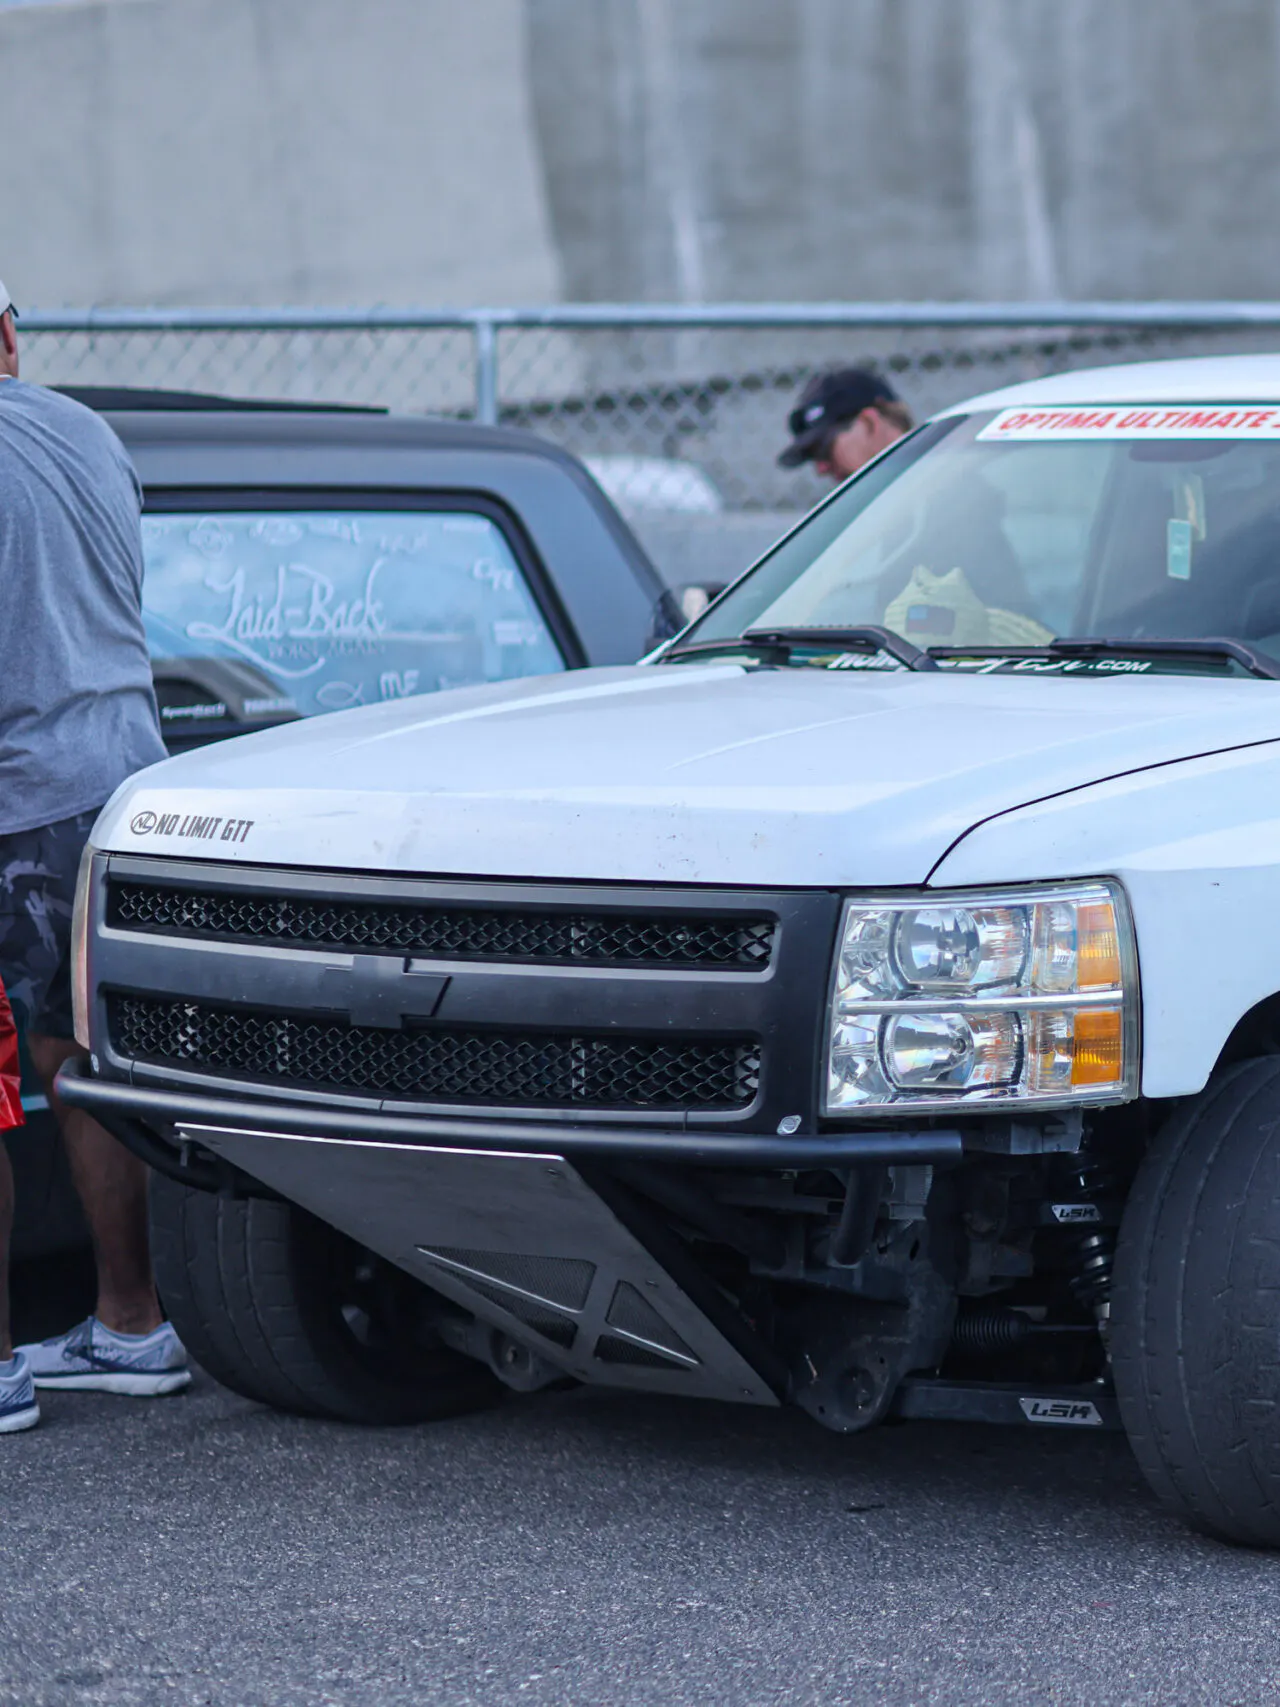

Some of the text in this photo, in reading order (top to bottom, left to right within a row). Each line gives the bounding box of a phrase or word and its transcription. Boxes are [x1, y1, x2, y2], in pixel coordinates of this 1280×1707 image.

[1000, 412, 1118, 430] OPTIMA
[1116, 411, 1276, 429] ULTIMATE
[154, 814, 180, 835] NO
[178, 815, 222, 839] LIMIT
[220, 819, 254, 842] GTT
